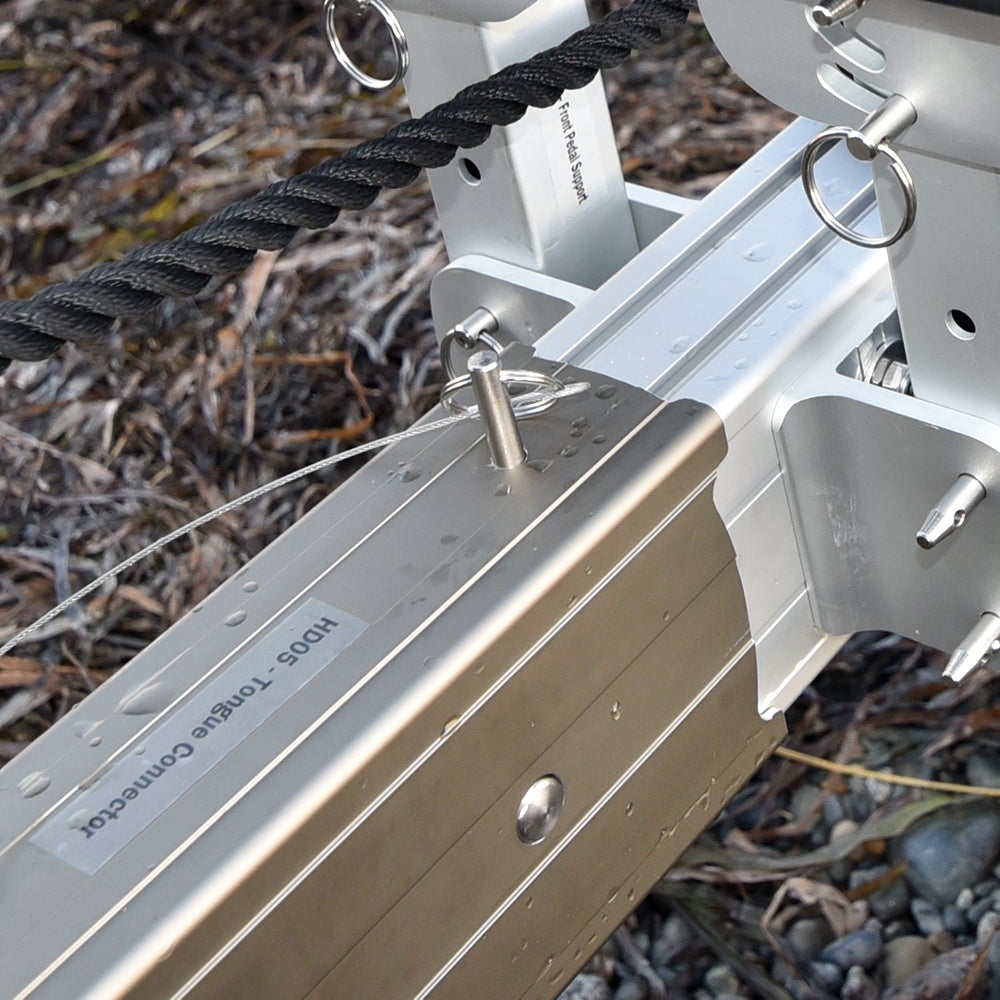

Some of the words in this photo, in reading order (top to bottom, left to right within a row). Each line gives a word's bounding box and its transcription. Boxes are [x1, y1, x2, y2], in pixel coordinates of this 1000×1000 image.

[558, 101, 572, 132] Front
[564, 131, 580, 163] Pedal
[571, 161, 589, 205] Support
[278, 616, 339, 667] HD05
[191, 676, 273, 739] Tongue
[81, 741, 195, 839] Connector
